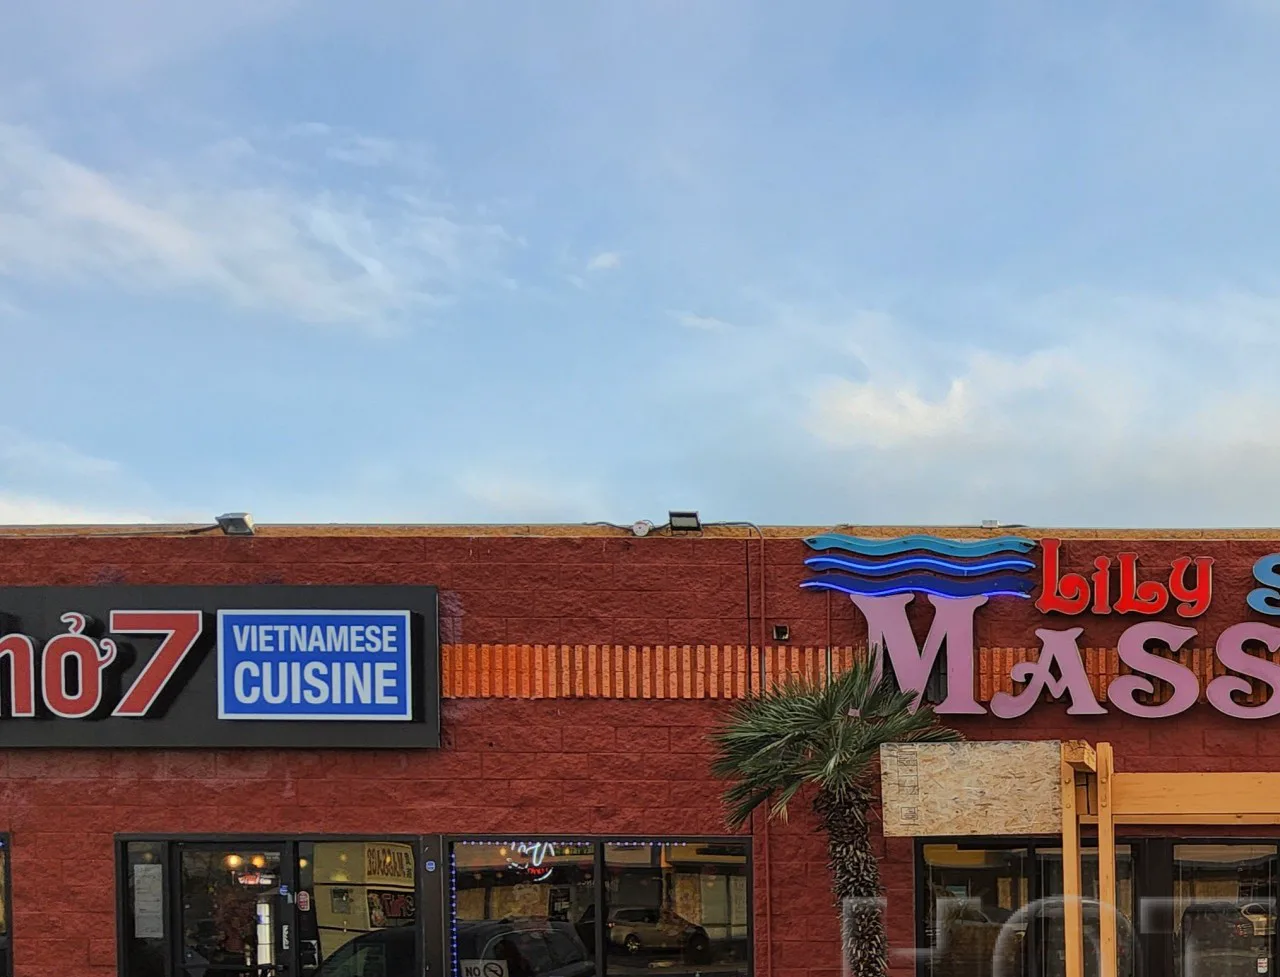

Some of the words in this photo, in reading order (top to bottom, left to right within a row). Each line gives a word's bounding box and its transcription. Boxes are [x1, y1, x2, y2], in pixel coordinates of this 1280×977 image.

[232, 624, 398, 653] VIETNAMESE
[233, 660, 399, 704] CUISINE
[465, 966, 481, 977] NO
